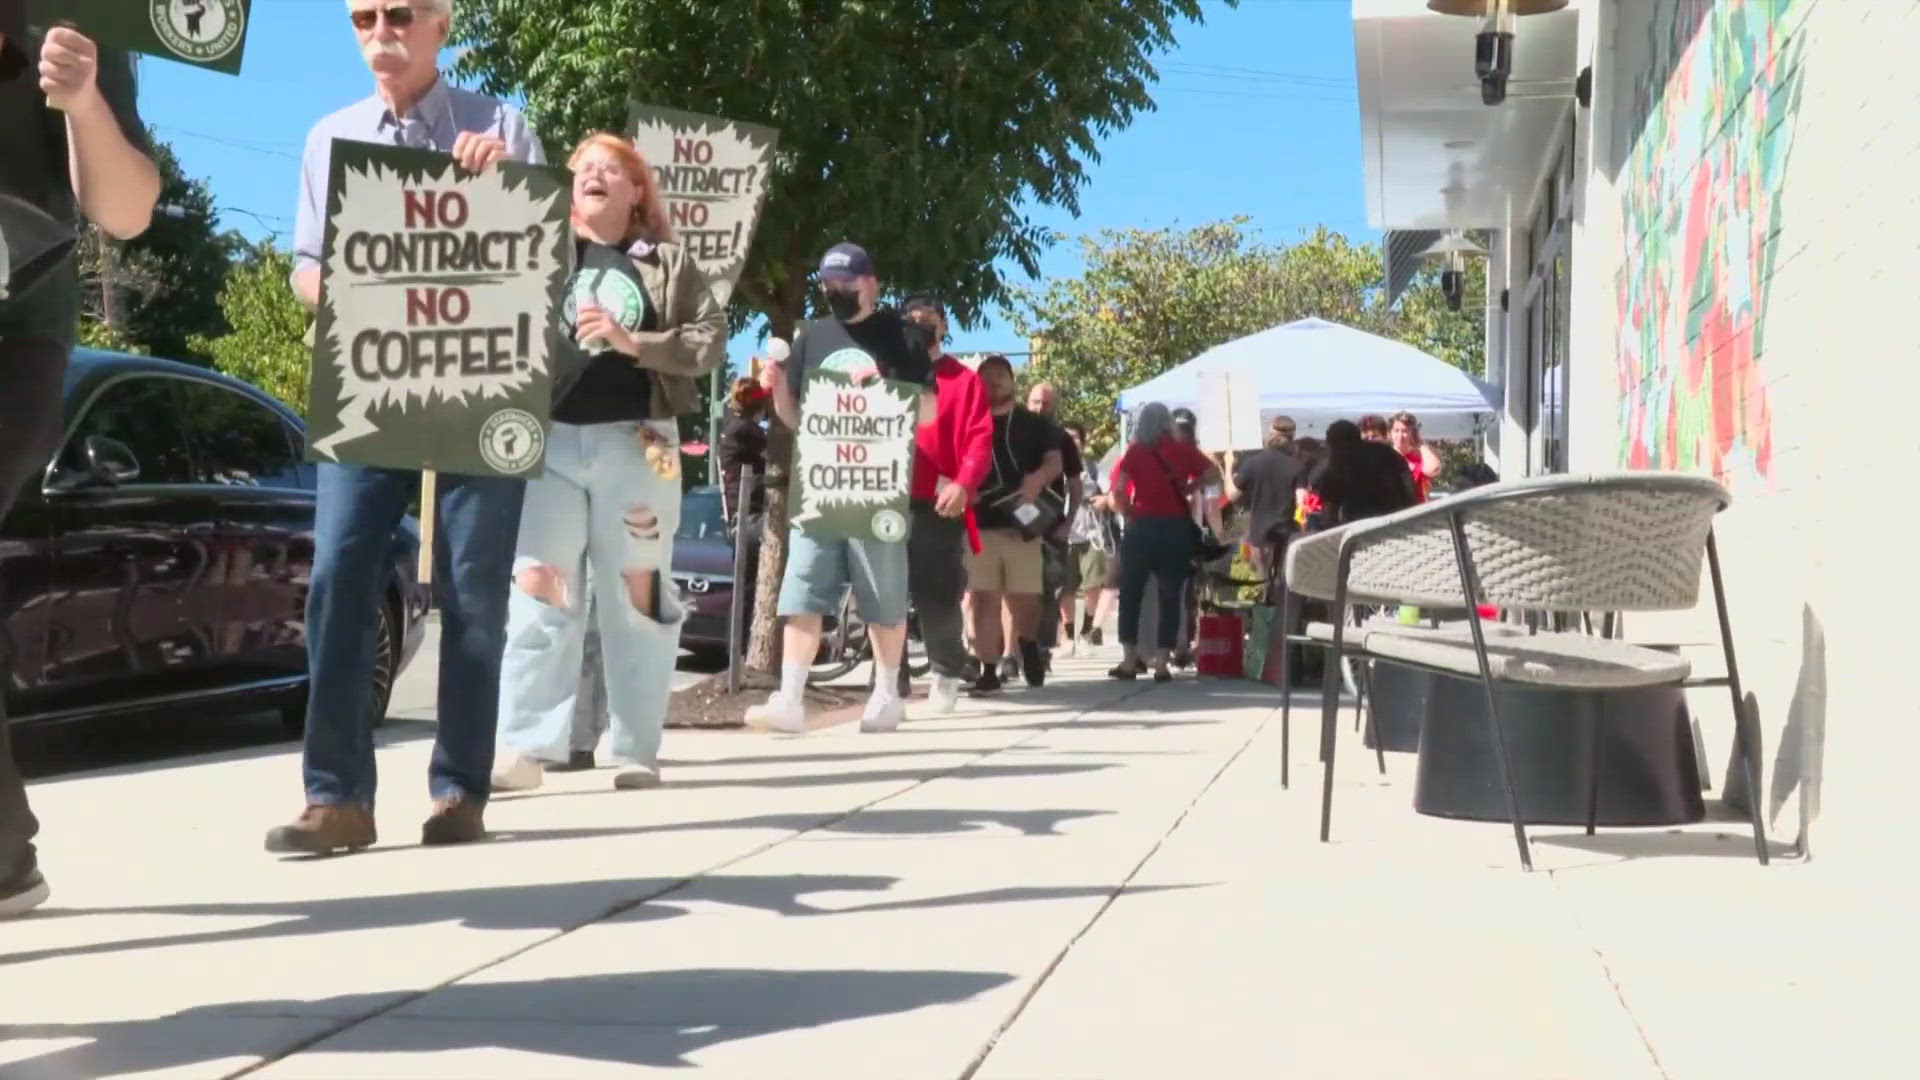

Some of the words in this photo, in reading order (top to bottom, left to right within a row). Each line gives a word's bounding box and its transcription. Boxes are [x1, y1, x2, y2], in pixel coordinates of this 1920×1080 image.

[673, 138, 714, 164] NO
[651, 165, 758, 193] ONTRACT?
[403, 189, 470, 229] NO
[669, 202, 710, 227] NO
[343, 224, 546, 274] CONTRACT?
[406, 287, 471, 327] NO
[351, 312, 532, 382] COFFEE!
[836, 393, 868, 414] NO
[807, 413, 906, 437] CONTRACT?
[836, 444, 867, 464] NO
[809, 459, 899, 491] COFFEE!
